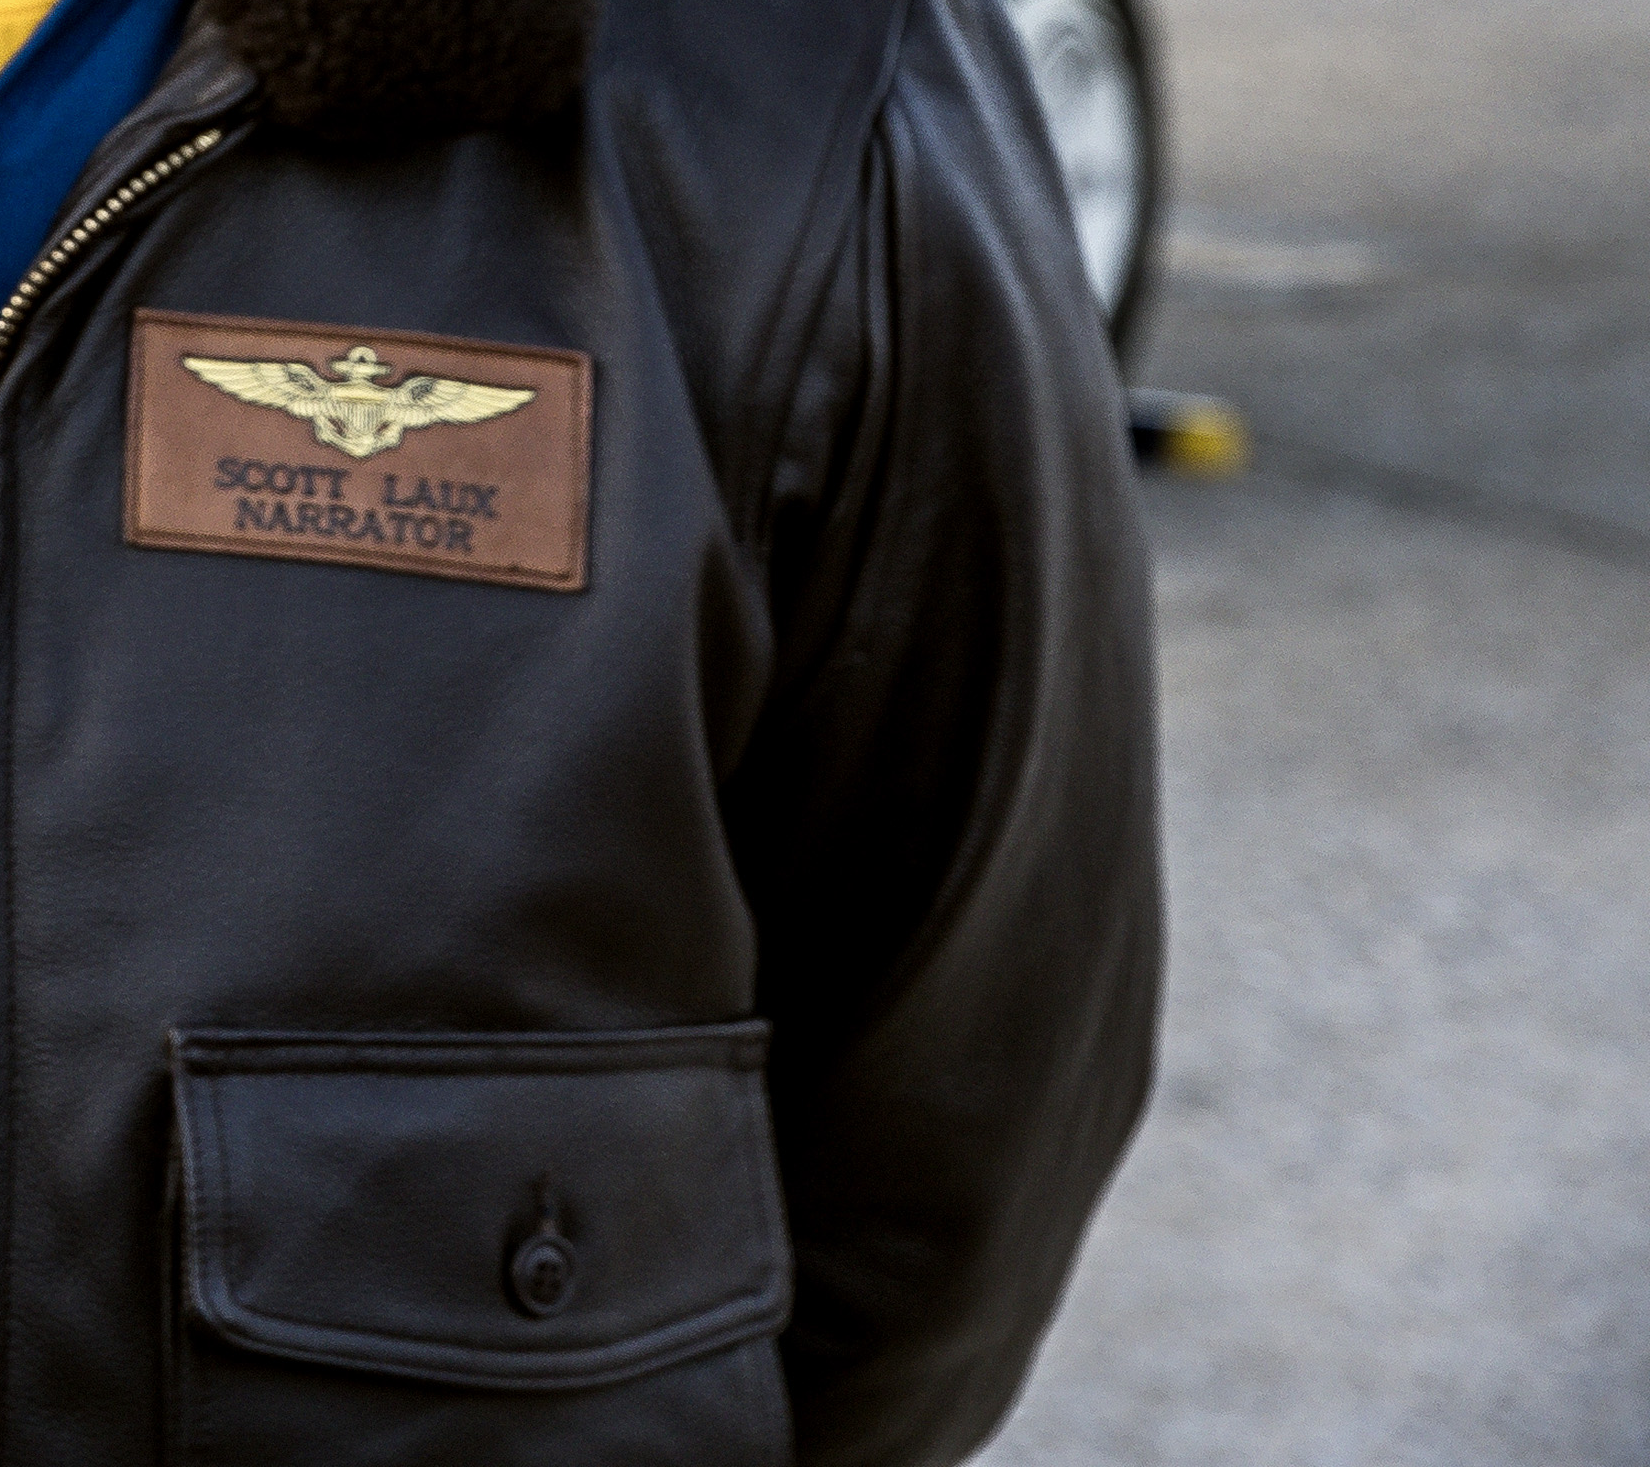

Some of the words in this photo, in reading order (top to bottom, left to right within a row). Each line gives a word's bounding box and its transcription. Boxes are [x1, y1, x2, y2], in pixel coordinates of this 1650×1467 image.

[215, 457, 350, 500] SCOTT
[383, 474, 500, 519] LAUX
[235, 498, 474, 554] NARRATOR
